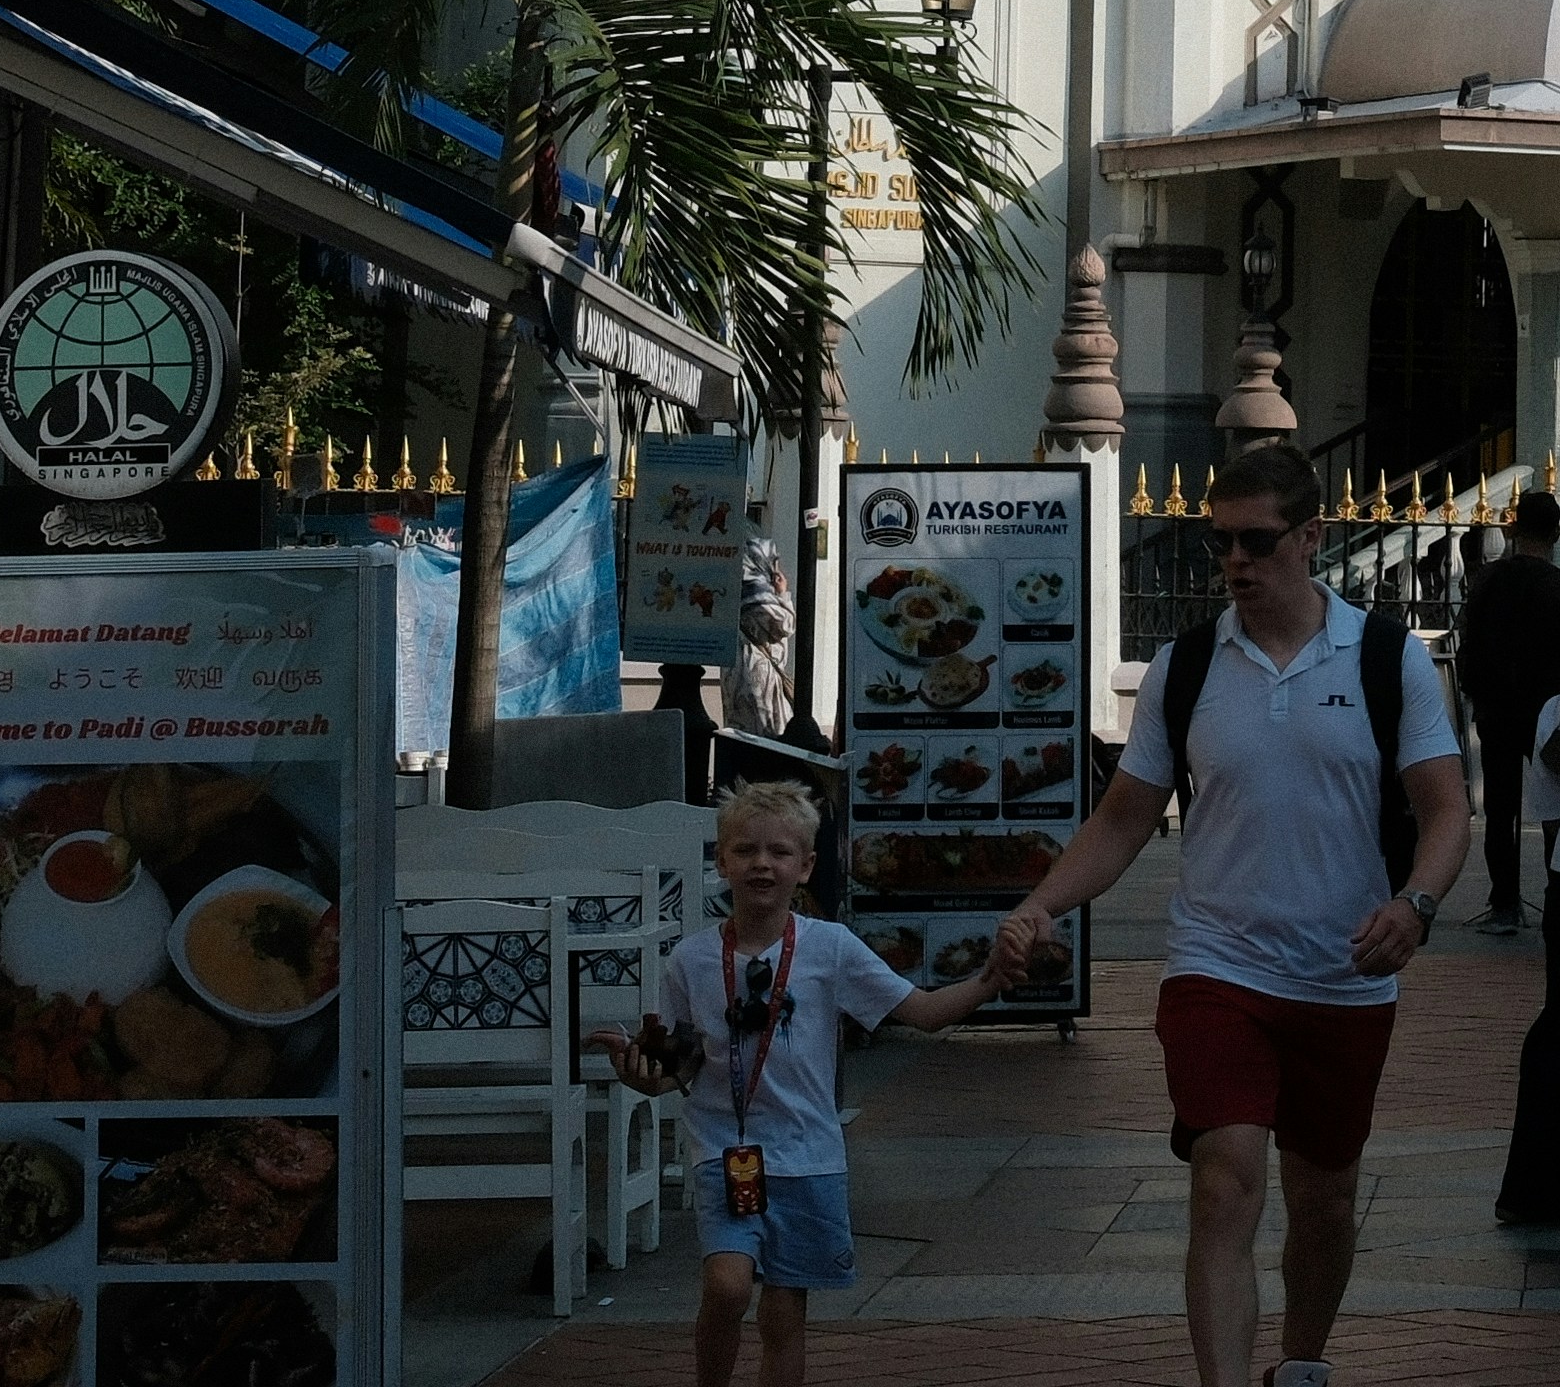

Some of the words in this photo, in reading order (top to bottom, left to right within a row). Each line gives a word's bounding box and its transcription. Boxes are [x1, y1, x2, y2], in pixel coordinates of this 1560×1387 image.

[126, 269, 162, 291] MAJLIS
[162, 287, 190, 320] UGAMA
[188, 320, 204, 355] ISLAM
[584, 305, 629, 370] AYASOFYA
[657, 343, 703, 408] RESTAURANT
[186, 354, 205, 417] SINGAPURA
[39, 370, 169, 448] حلال
[68, 449, 137, 463] HALAL
[38, 467, 170, 480] SINGAPORE
[925, 501, 1067, 520] AYASOFYA
[926, 524, 981, 535] TURKISH
[984, 524, 1069, 535] RESTAURANT
[636, 541, 669, 556] WHAT
[672, 544, 681, 556] IS
[686, 545, 739, 559] TOUTING?
[95, 623, 193, 646] Datang
[48, 668, 143, 691] ようこそ
[174, 667, 223, 691] 欢迎
[42, 718, 70, 740] to
[78, 717, 144, 739] Padi
[149, 718, 178, 739] @
[184, 714, 330, 737] Bussorah
